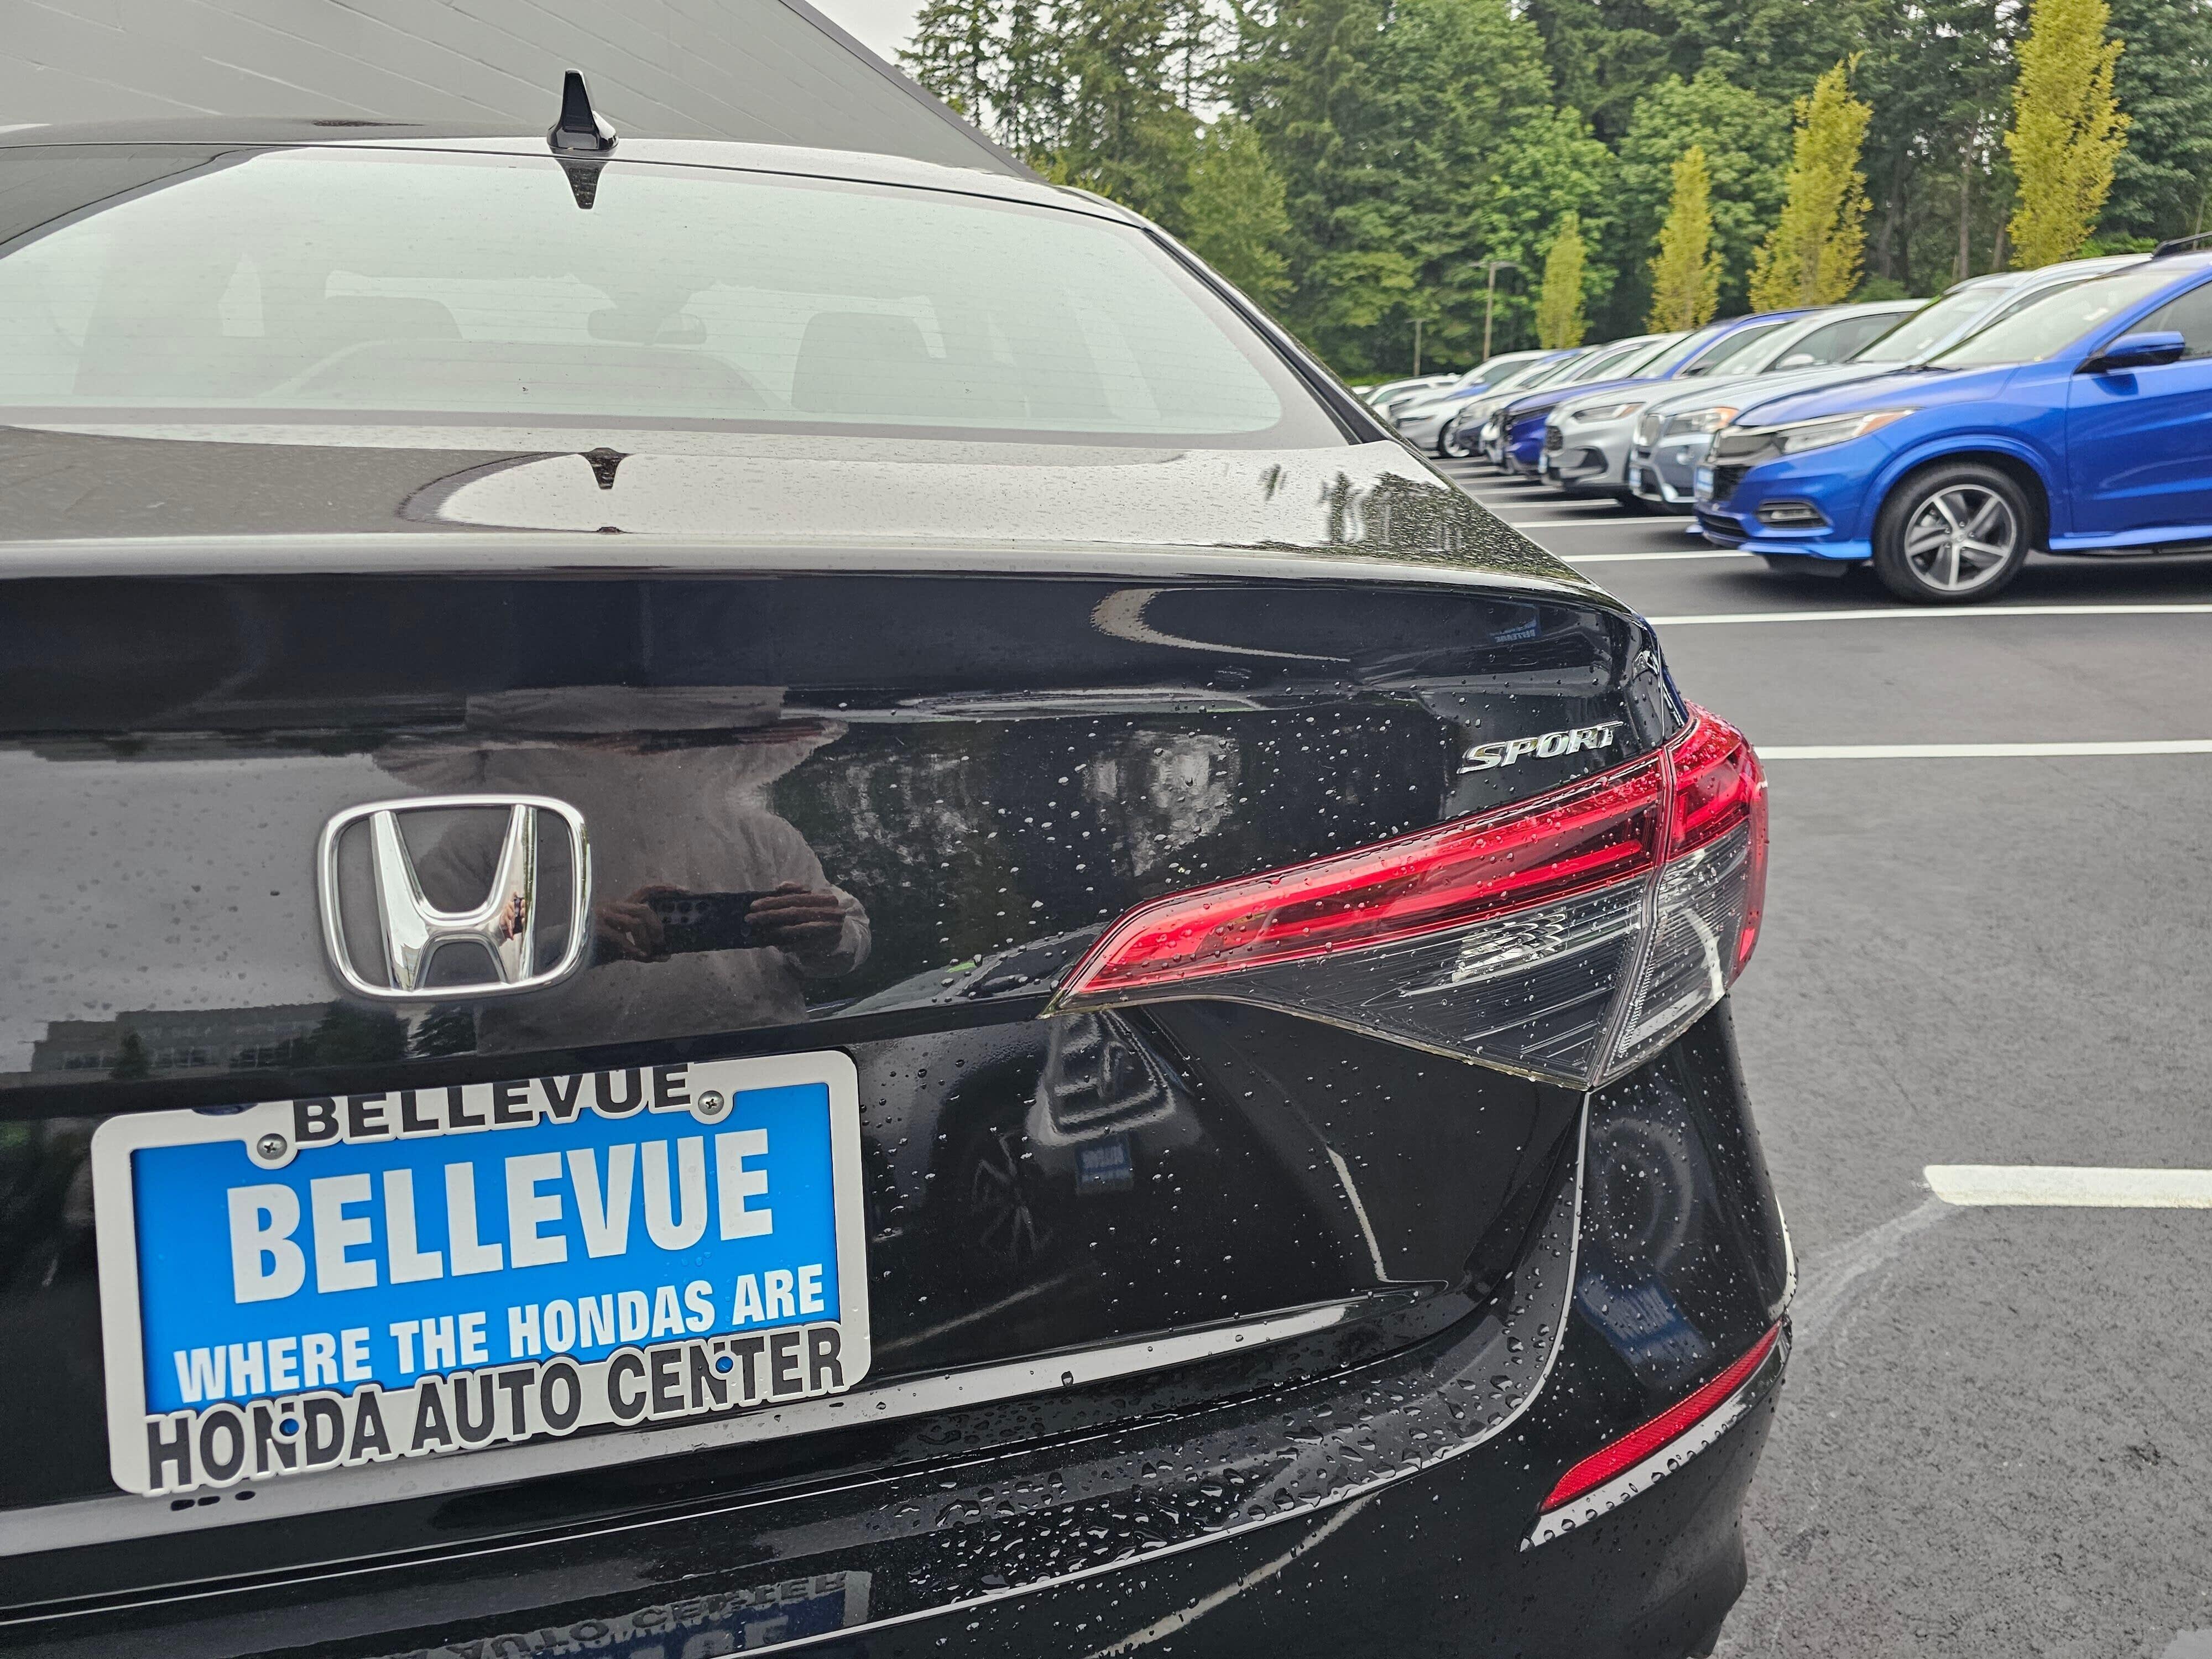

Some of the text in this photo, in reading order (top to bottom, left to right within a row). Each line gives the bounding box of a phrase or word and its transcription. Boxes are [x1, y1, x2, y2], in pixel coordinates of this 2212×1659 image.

[1456, 721, 1624, 774] SPORT
[293, 1063, 691, 1142] BELLEVUE
[227, 1129, 773, 1305] BELLEVUE
[174, 1264, 825, 1404] WHERE THE HONDAS ARE
[147, 1327, 844, 1490] HONDA AUTO CENTER
